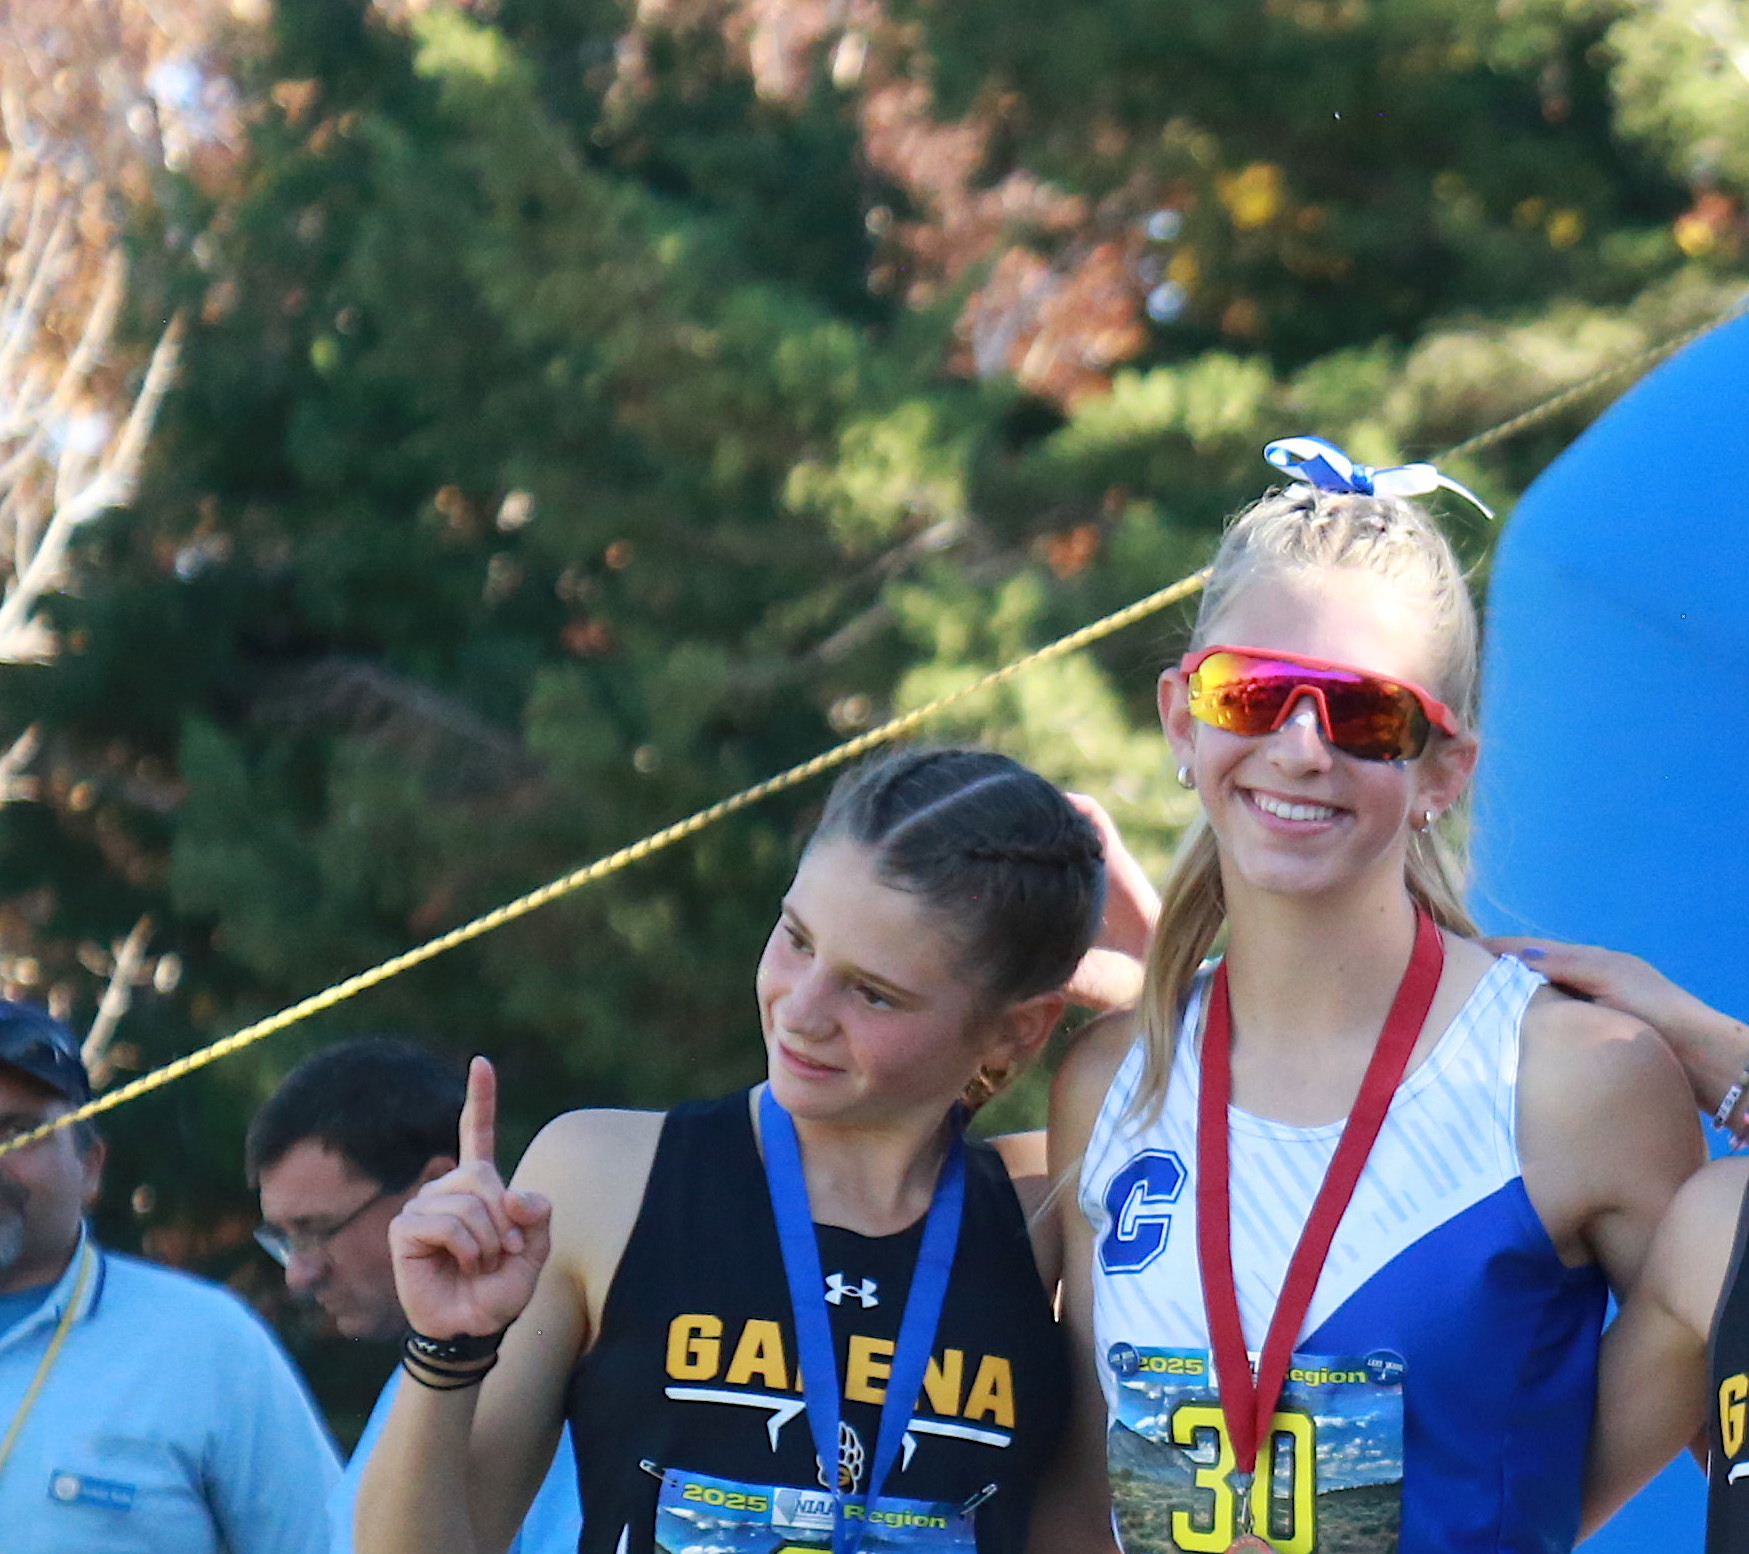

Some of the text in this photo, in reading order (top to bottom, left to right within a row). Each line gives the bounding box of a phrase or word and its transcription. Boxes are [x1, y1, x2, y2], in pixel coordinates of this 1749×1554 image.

[1097, 1147, 1187, 1275] C
[665, 1313, 1017, 1428] GAENA
[1139, 1356, 1204, 1376] 2025
[1284, 1367, 1367, 1388] egion
[682, 1483, 769, 1513] 2025
[843, 1504, 947, 1530] Region
